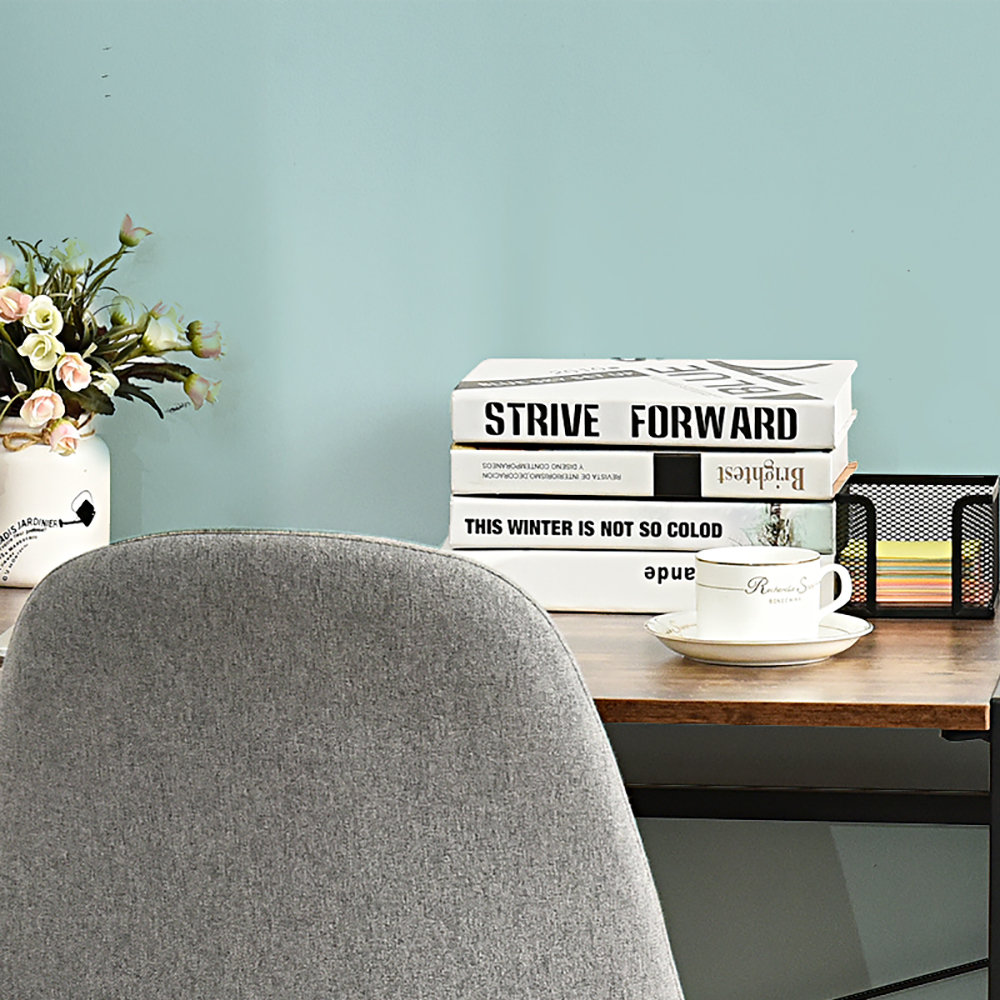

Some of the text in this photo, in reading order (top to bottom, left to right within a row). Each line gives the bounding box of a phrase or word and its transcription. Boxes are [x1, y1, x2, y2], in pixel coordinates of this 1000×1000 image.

[485, 402, 798, 440] STRIVE FORWARD
[718, 460, 805, 491] Brightest
[465, 518, 723, 539] THIS WINTER IS NOT SO COLOD
[645, 566, 696, 585] ande
